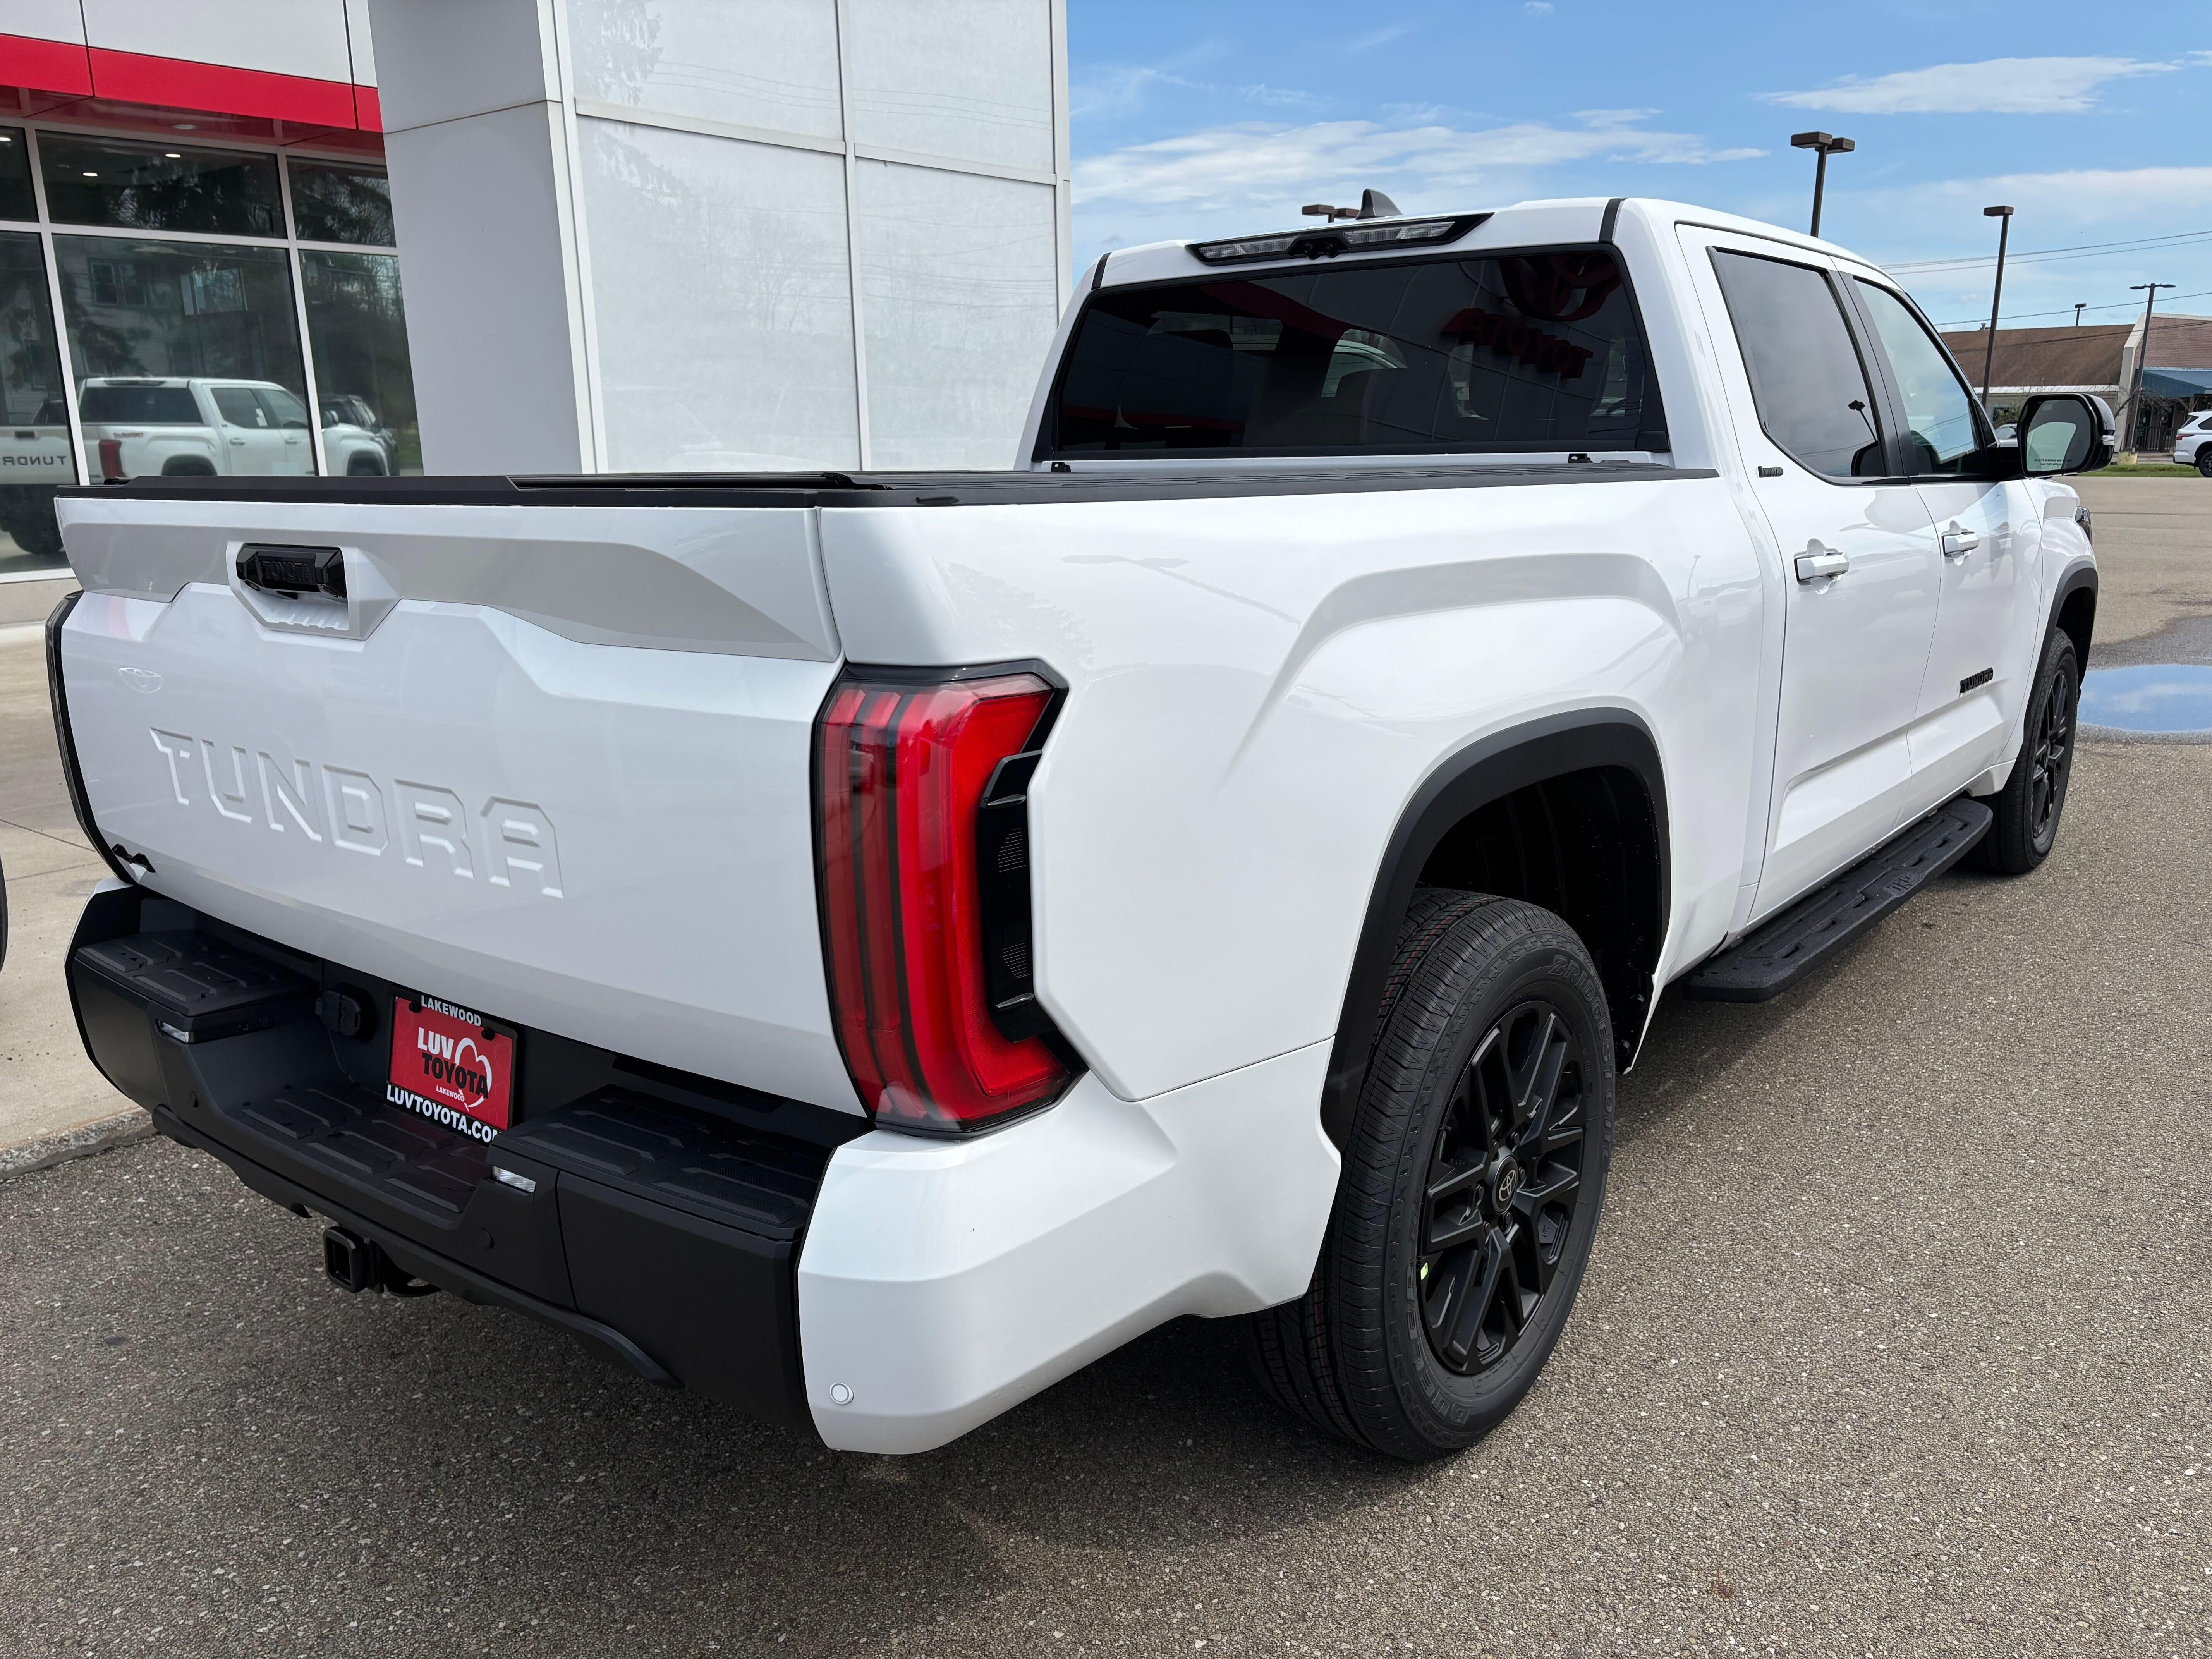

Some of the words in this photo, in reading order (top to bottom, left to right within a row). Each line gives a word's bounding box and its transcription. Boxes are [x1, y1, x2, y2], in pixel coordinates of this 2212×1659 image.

[263, 560, 313, 582] TOYOTA
[1960, 667, 1994, 693] TUNDRA
[149, 726, 564, 899] TUNDRA
[421, 995, 482, 1027] LAKEWOOD
[417, 1027, 454, 1060] LUV
[422, 1053, 489, 1099] TOYOTA
[436, 1085, 465, 1102] LAKEWOOD
